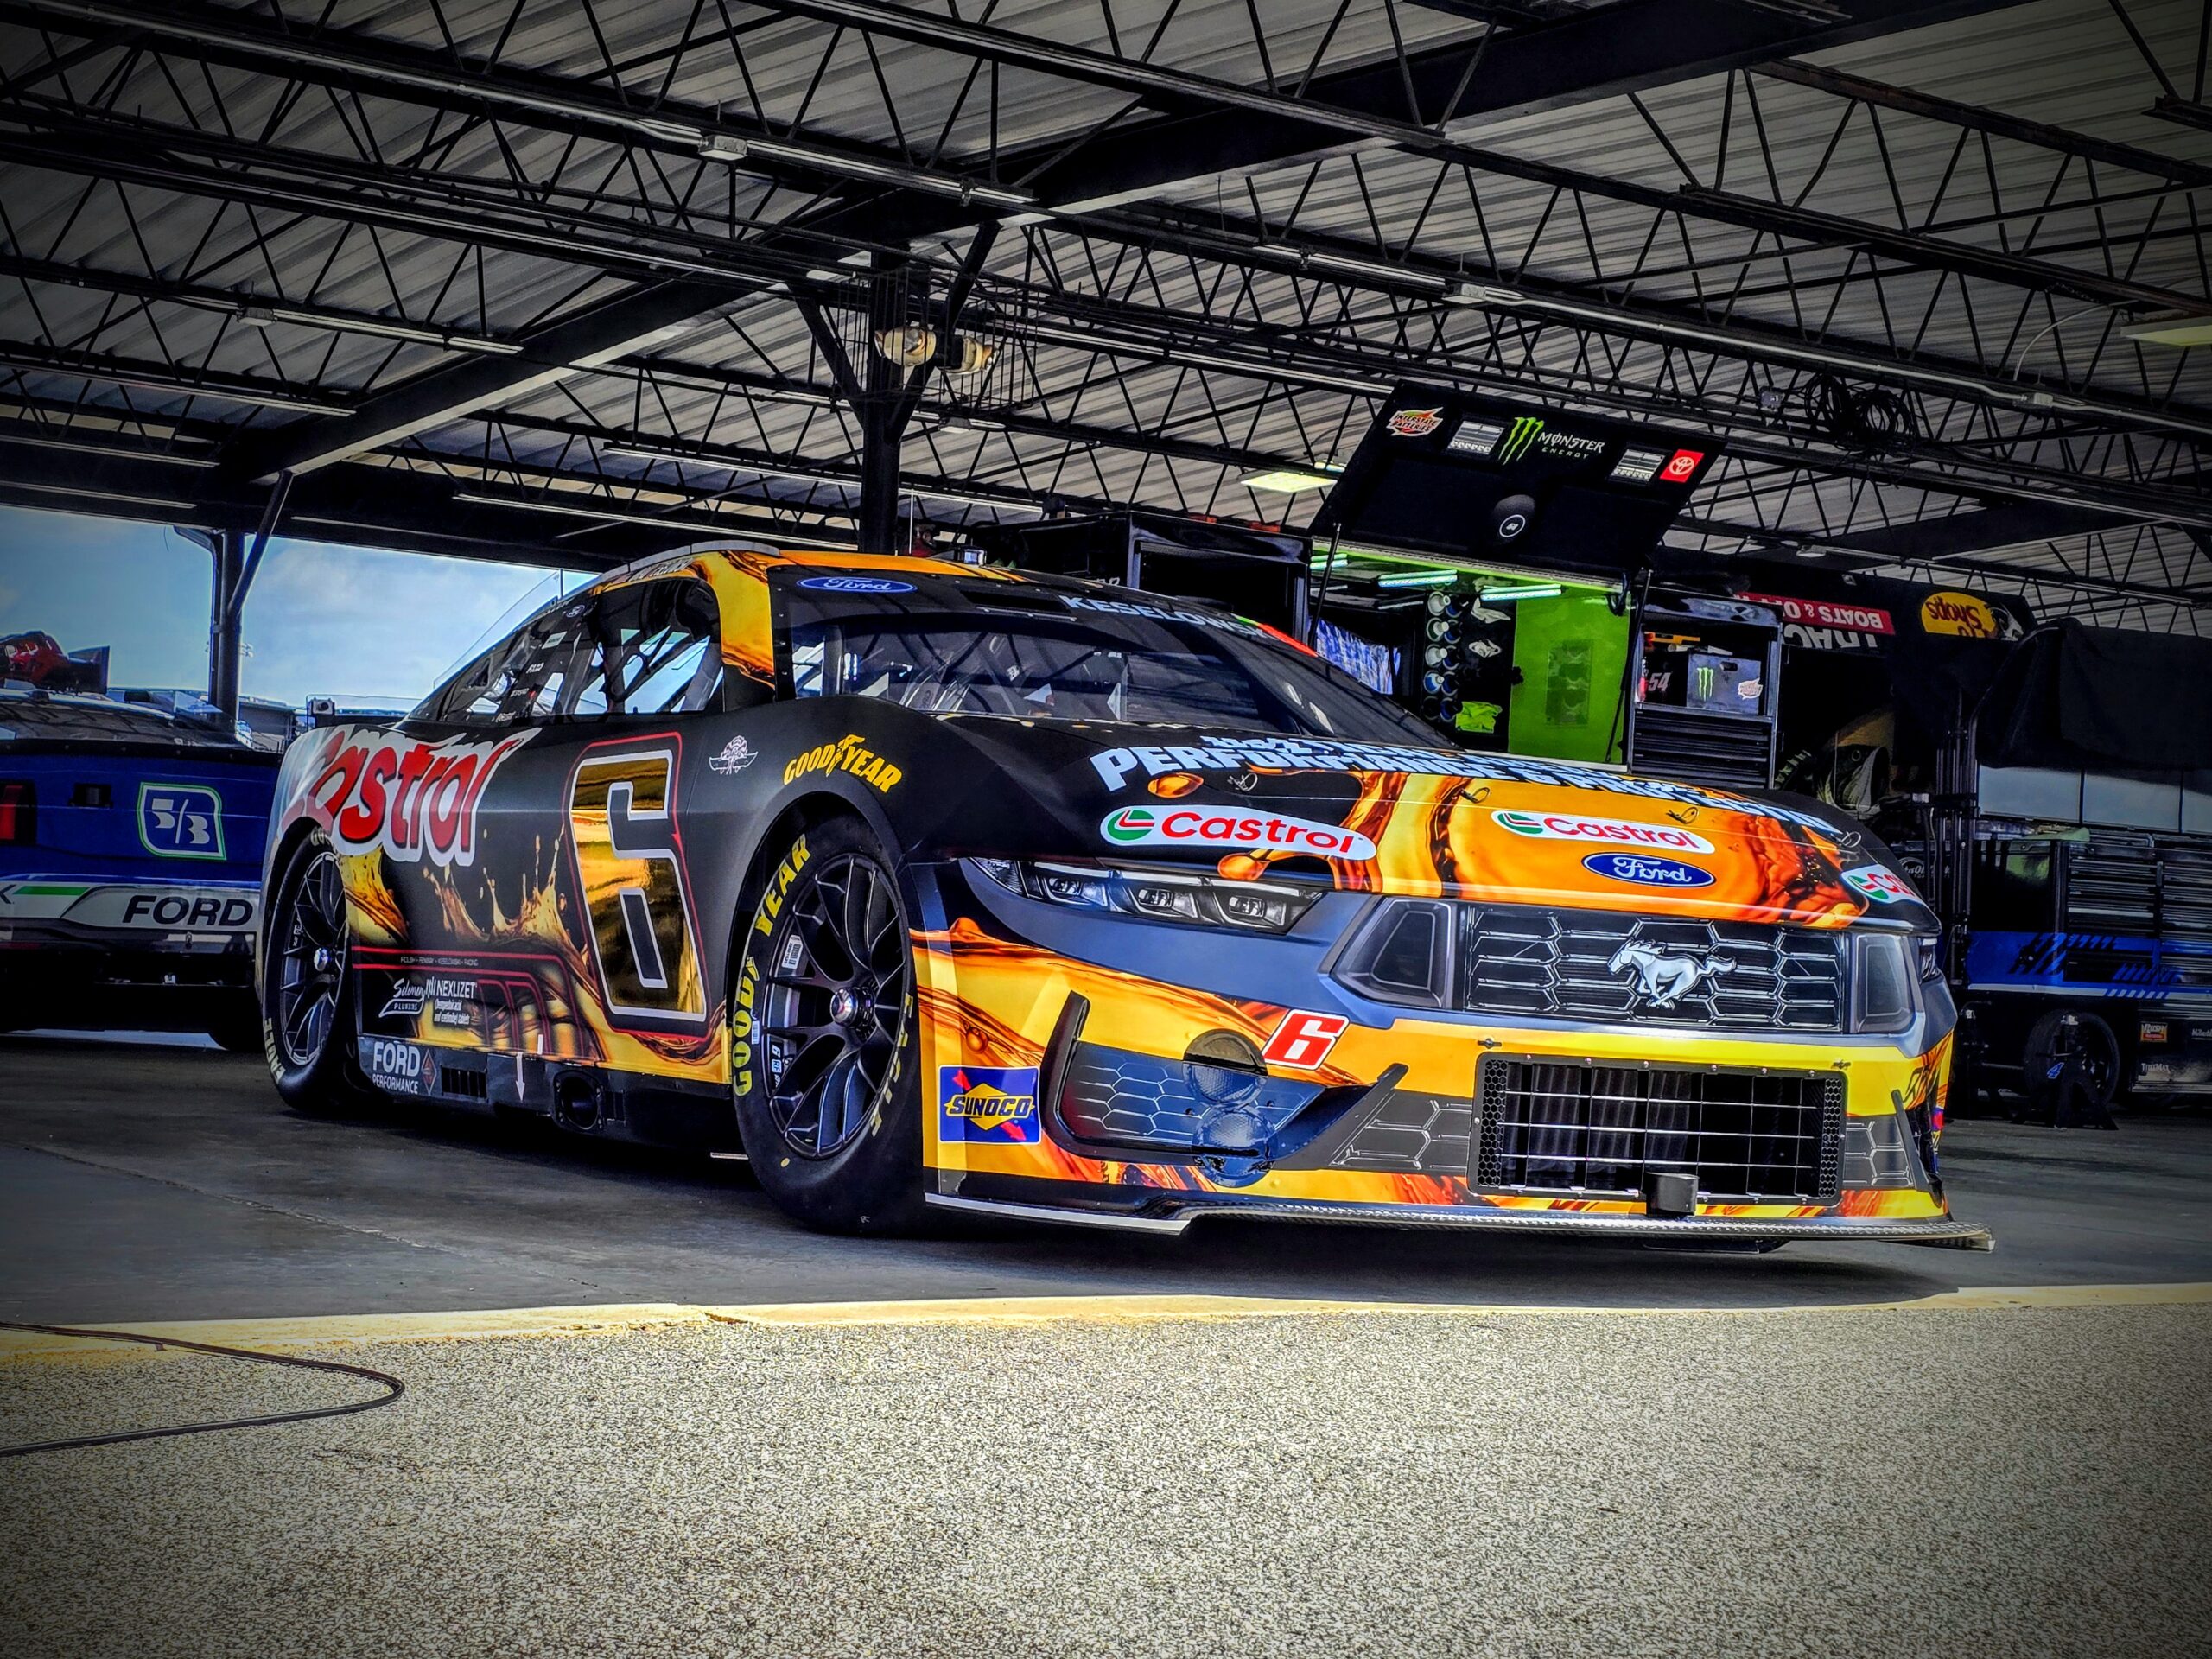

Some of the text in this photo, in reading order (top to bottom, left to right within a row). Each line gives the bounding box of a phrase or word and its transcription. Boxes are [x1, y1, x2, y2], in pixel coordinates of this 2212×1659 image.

[1537, 431, 1605, 454] MONSTER
[1541, 447, 1590, 460] ENERGY
[823, 578, 893, 591] Ford
[1818, 605, 1884, 629] BOATS
[1647, 671, 1672, 692] 54
[1161, 811, 1353, 854] Castrol
[1543, 817, 1700, 850] Castrol
[1613, 855, 1693, 885] Ford
[569, 749, 706, 1022] 6
[122, 894, 253, 927] FORD
[1267, 1012, 1346, 1067] 6
[372, 1040, 421, 1077] FORD
[2046, 1061, 2065, 1079] 4
[372, 1073, 419, 1096] PERFORMANCE
[949, 1096, 1032, 1116] SUNOCO
